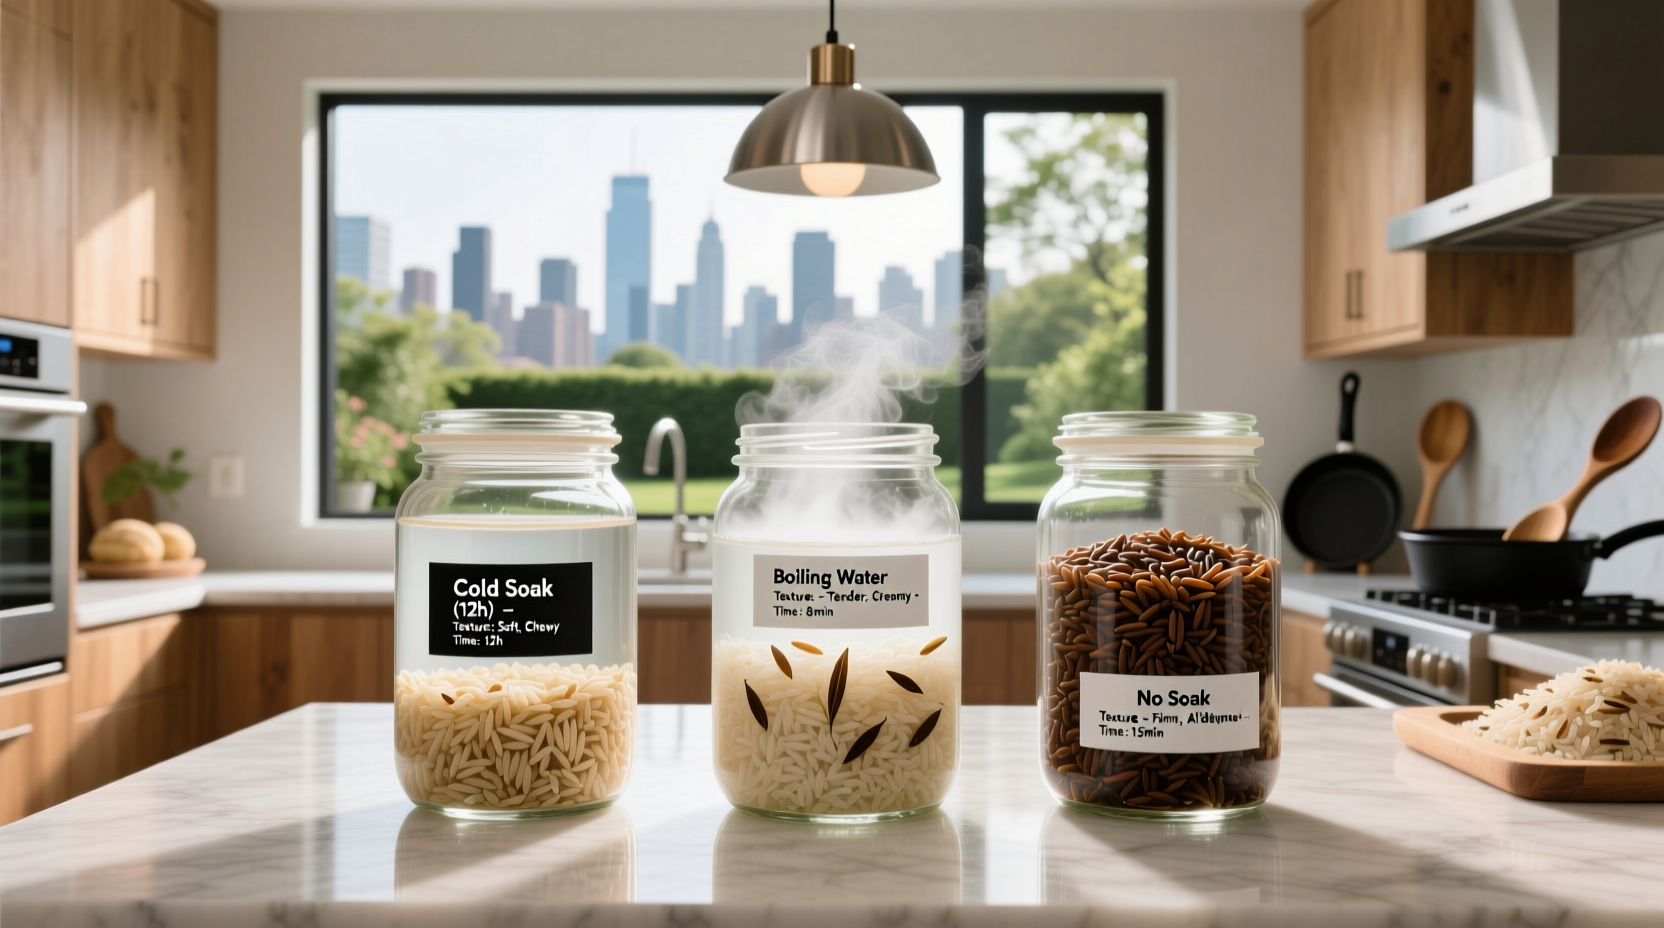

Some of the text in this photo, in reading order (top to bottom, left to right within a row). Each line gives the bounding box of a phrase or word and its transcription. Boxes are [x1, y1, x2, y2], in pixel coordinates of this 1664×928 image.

[836, 568, 889, 586] Water
[453, 577, 554, 598] Cold Soak
[453, 599, 494, 621] (12h)
[805, 605, 834, 617] 8min
[484, 634, 503, 646] 12h
[1137, 688, 1211, 707] No Soak
[1131, 726, 1164, 739] 15min
